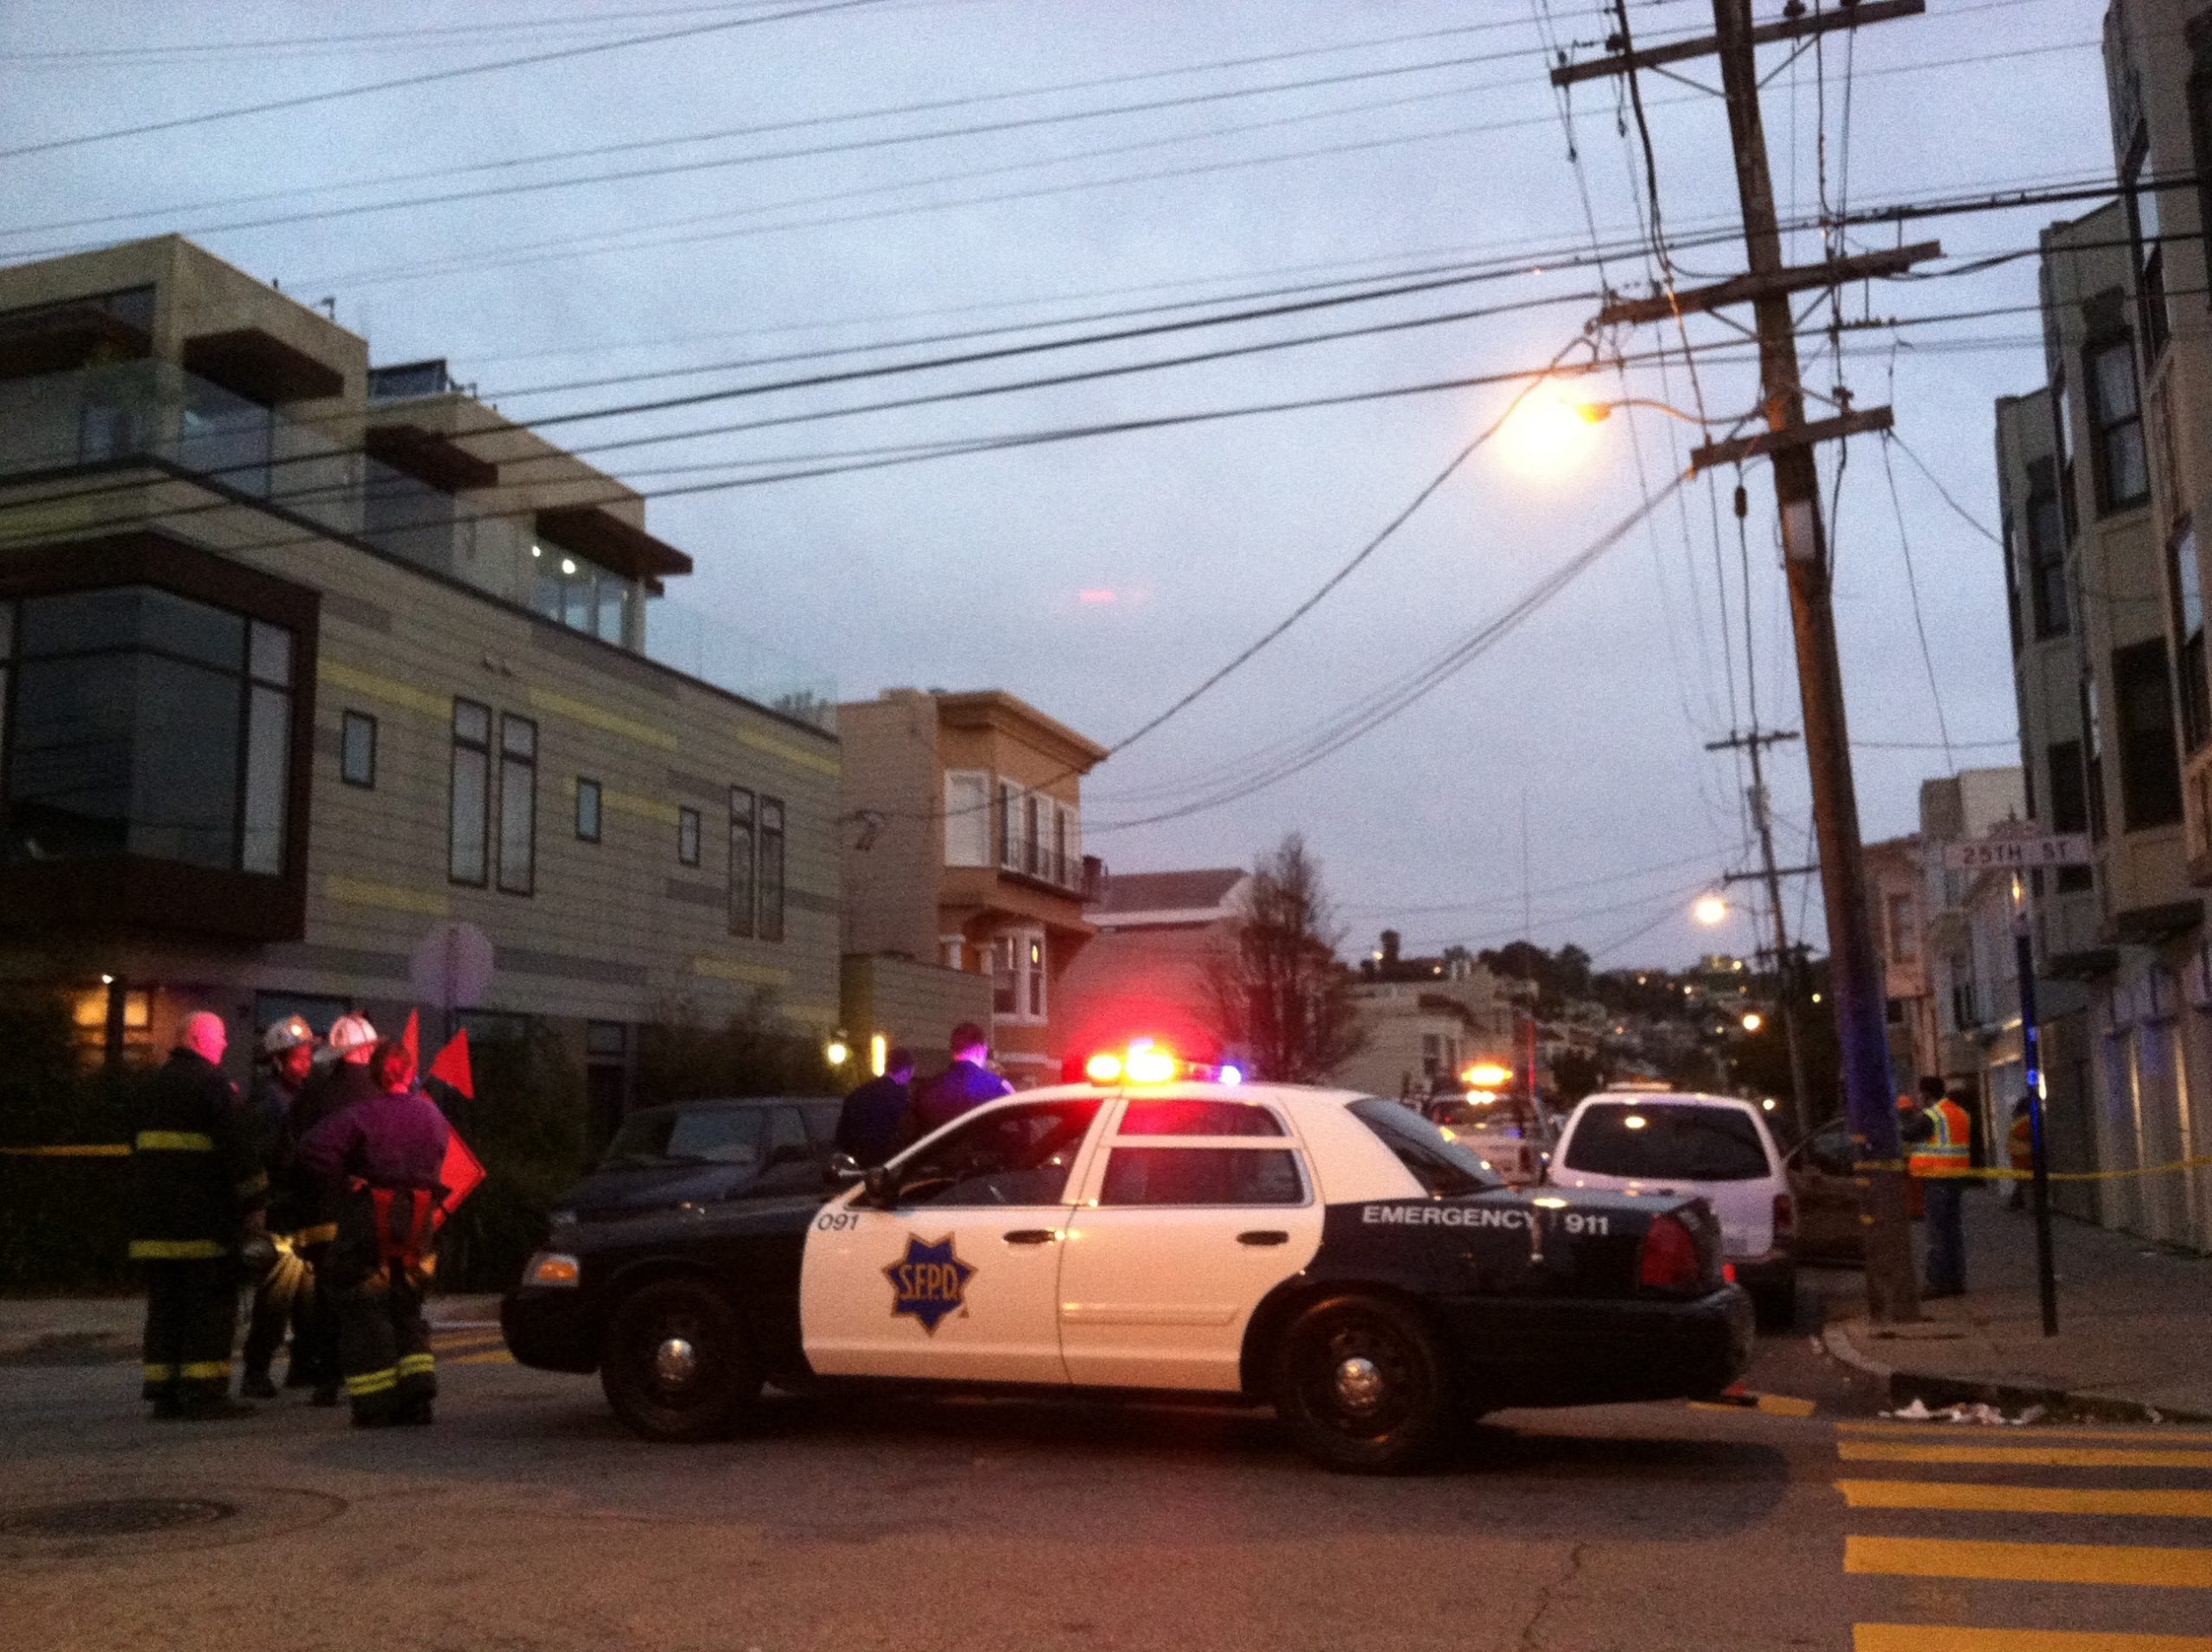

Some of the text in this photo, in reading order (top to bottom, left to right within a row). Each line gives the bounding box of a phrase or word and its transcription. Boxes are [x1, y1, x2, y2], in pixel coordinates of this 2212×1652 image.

[1962, 841, 2068, 865] 25TH ST
[817, 1213, 859, 1231] 091
[1363, 1205, 1609, 1236] EMERGENCY 911
